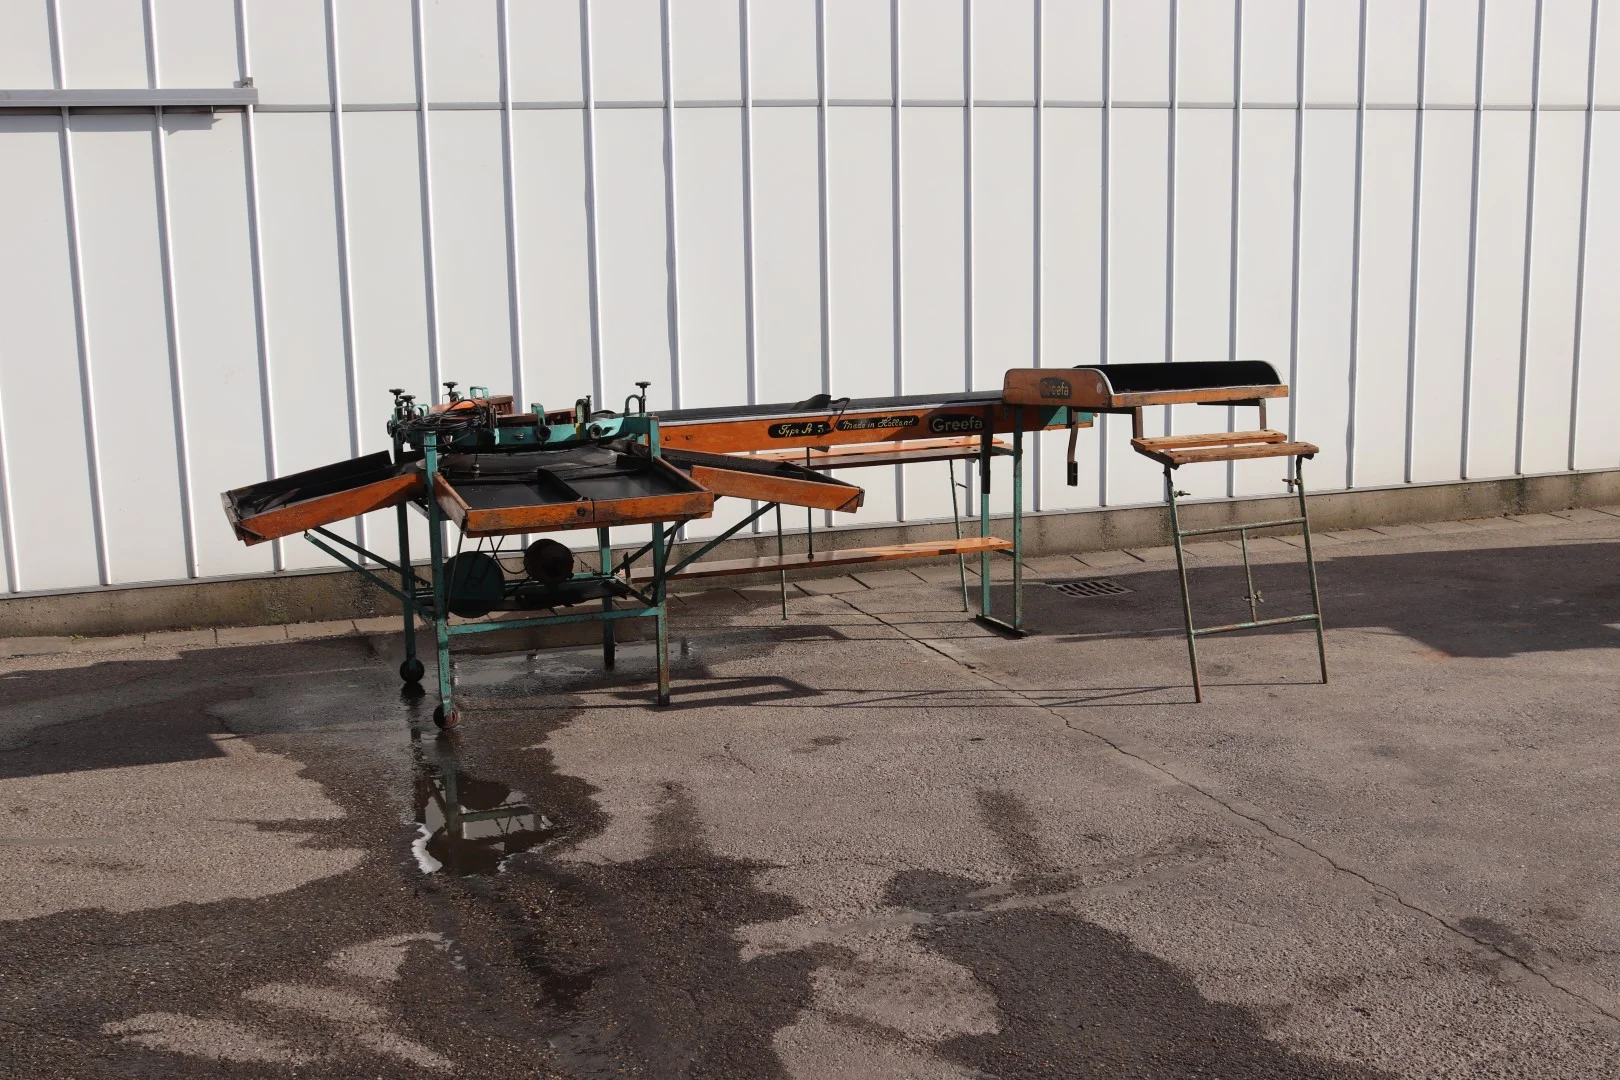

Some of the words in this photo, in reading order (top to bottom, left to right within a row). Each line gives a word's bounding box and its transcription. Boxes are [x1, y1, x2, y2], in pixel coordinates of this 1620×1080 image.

[1041, 381, 1069, 396] eefa
[843, 420, 866, 430] Made
[867, 420, 875, 429] in
[878, 416, 914, 428] Holland
[932, 416, 983, 431] Greefa
[778, 424, 800, 437] Type
